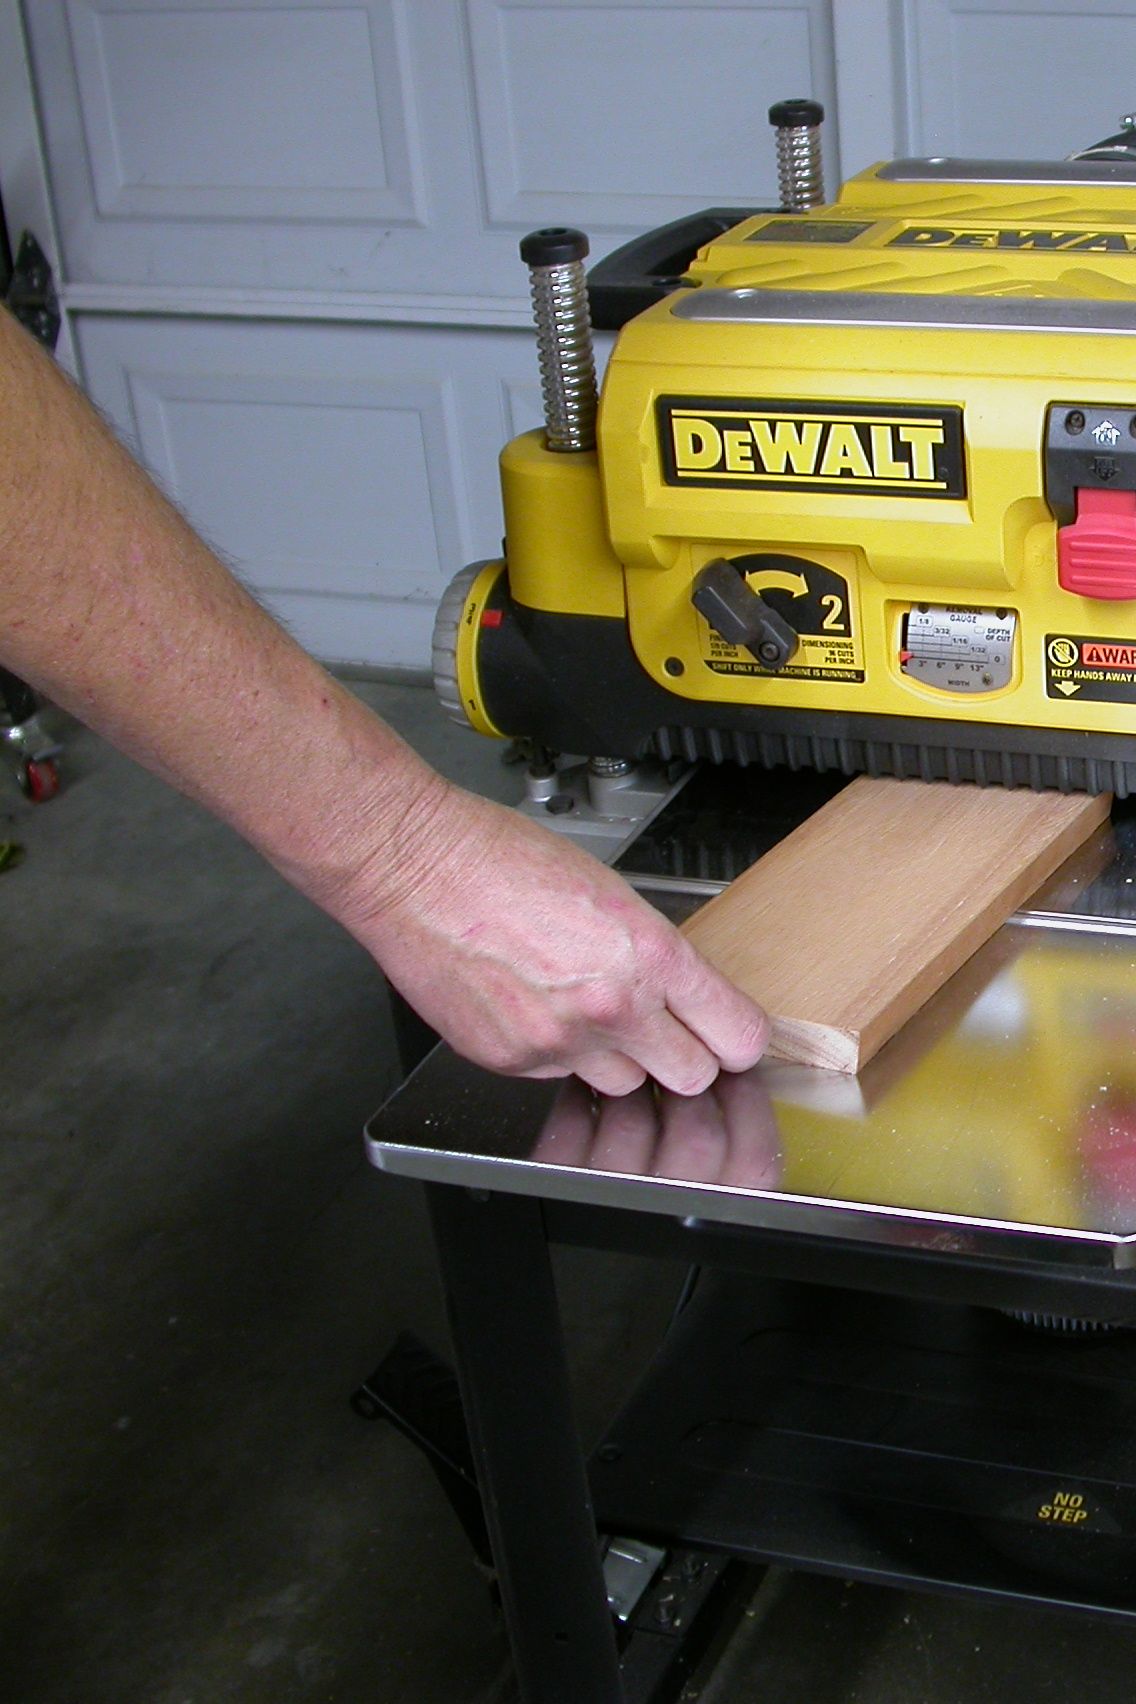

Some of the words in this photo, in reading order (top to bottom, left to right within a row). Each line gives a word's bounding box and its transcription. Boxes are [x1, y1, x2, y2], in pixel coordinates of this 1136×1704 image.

[821, 594, 845, 631] 2
[949, 614, 977, 624] GAUGE
[987, 627, 1011, 635] DEPTH
[801, 639, 854, 650] DIMENSIONING
[996, 635, 1011, 643] CUT
[1051, 668, 1072, 678] KEEP
[1073, 670, 1104, 680] HANDS
[1105, 672, 1133, 682] AWAY
[947, 679, 970, 687] WIDTH
[1053, 1492, 1083, 1508] NO
[1038, 1505, 1088, 1523] STEP
